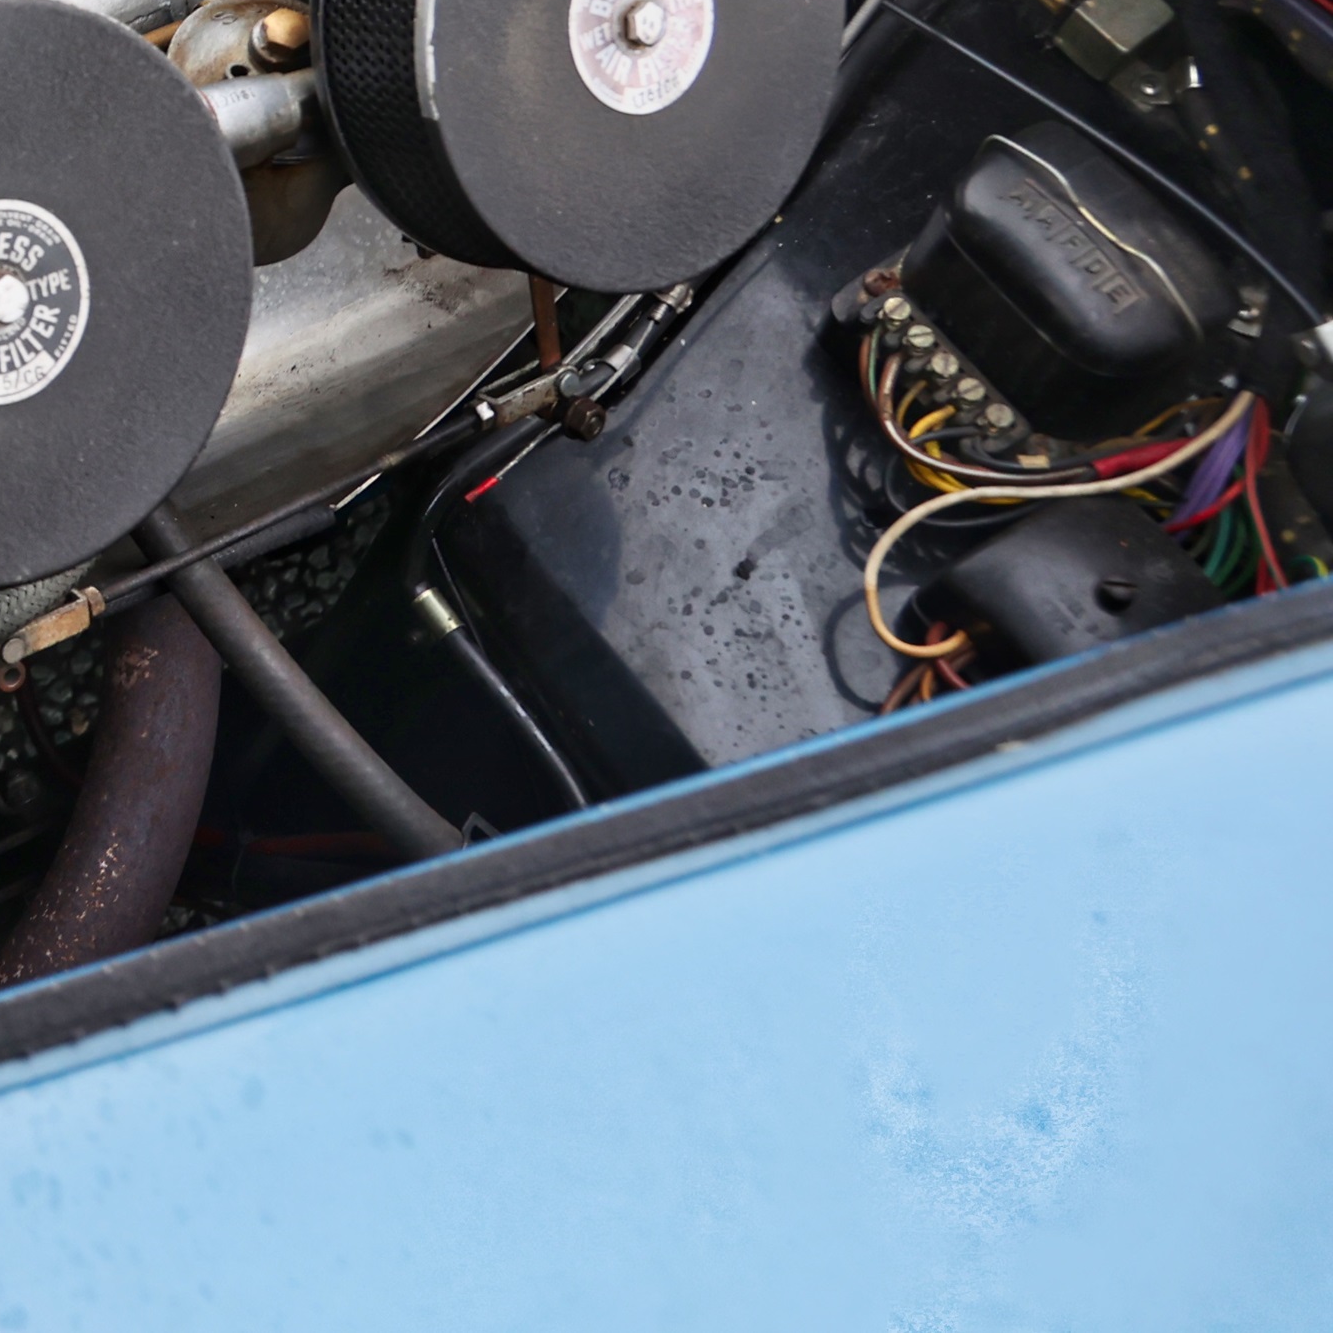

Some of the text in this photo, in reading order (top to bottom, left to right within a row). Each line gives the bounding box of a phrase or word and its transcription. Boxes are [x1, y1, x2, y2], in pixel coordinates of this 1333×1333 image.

[580, 22, 611, 51] WET
[595, 44, 632, 84] AIR
[26, 269, 72, 300] TYPE
[54, 314, 78, 358] FITTED
